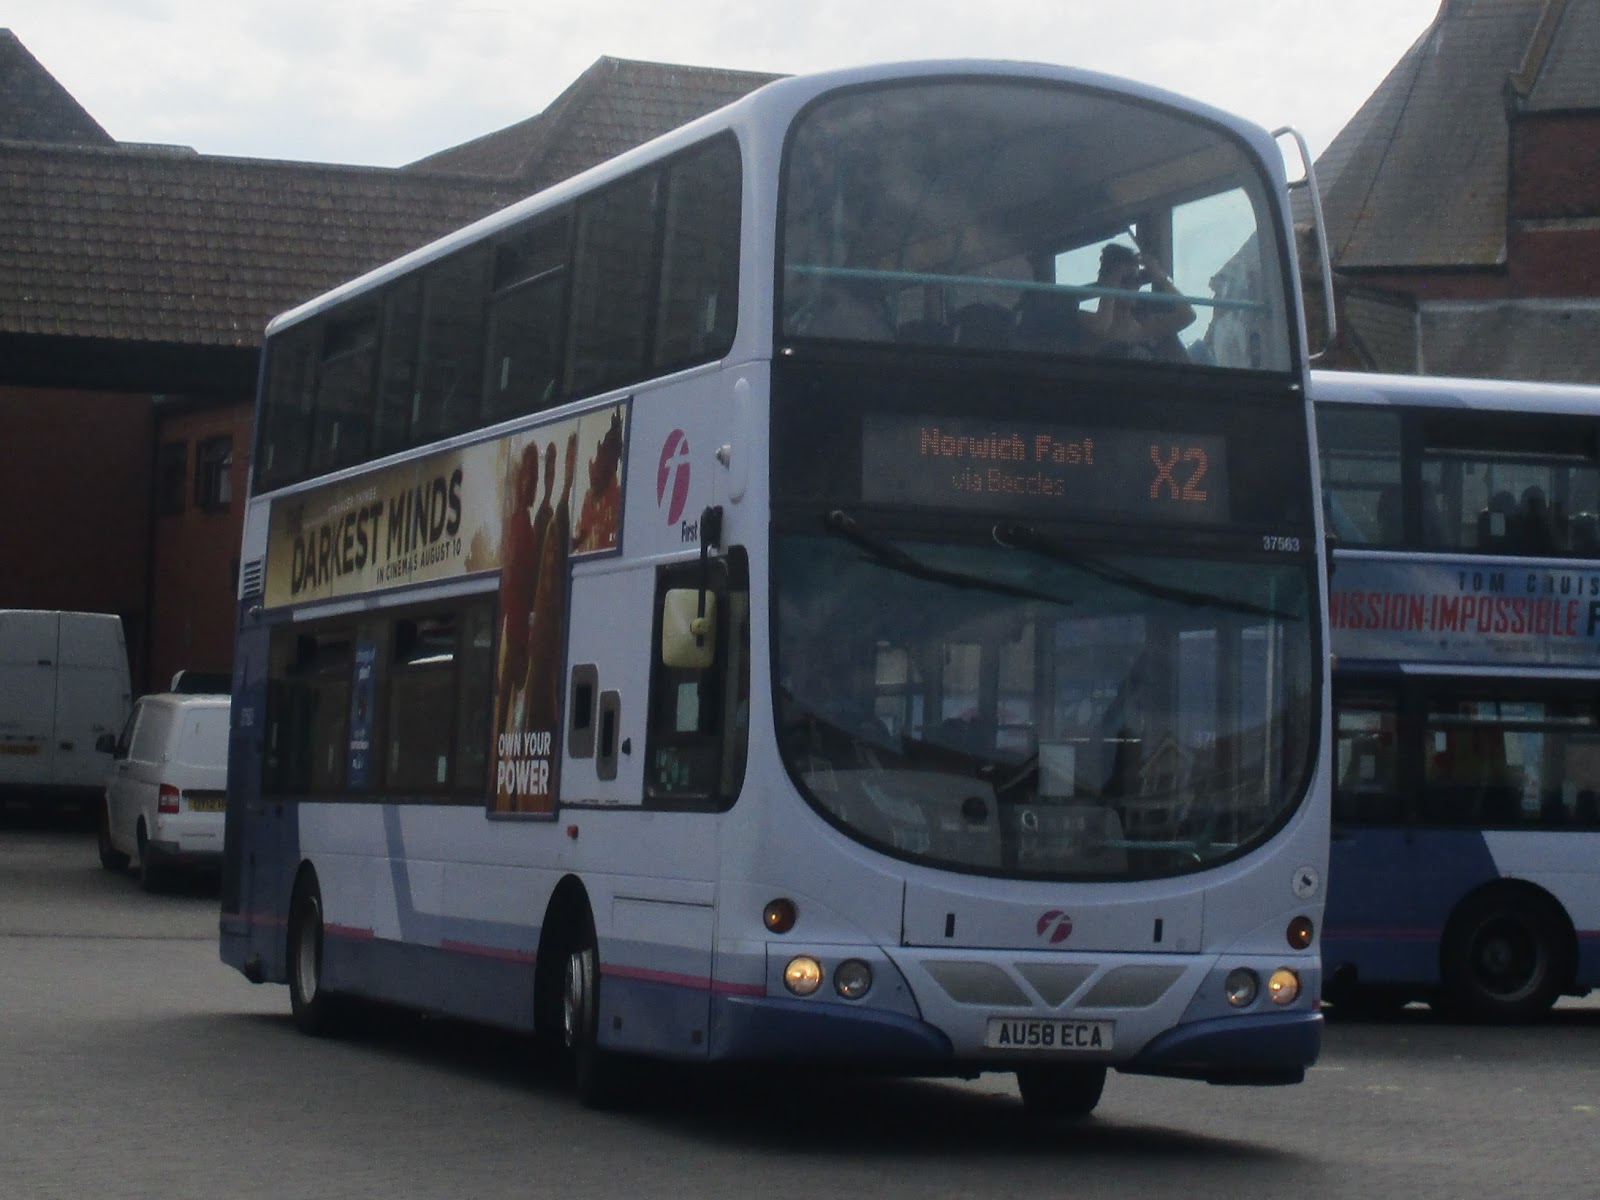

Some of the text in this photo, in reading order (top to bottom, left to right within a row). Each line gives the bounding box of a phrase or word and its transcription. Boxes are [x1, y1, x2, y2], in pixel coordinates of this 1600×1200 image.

[922, 428, 1094, 465] Norwich Fast
[1150, 443, 1209, 501] X2
[291, 468, 463, 595] DARKEST MINDS
[376, 537, 462, 585] IN CINEMAS AUGUST 10
[1457, 571, 1505, 593] TOM
[498, 731, 551, 757] OWN YOUR
[496, 759, 550, 795] POWER
[999, 1022, 1102, 1047] AU58 ECA
